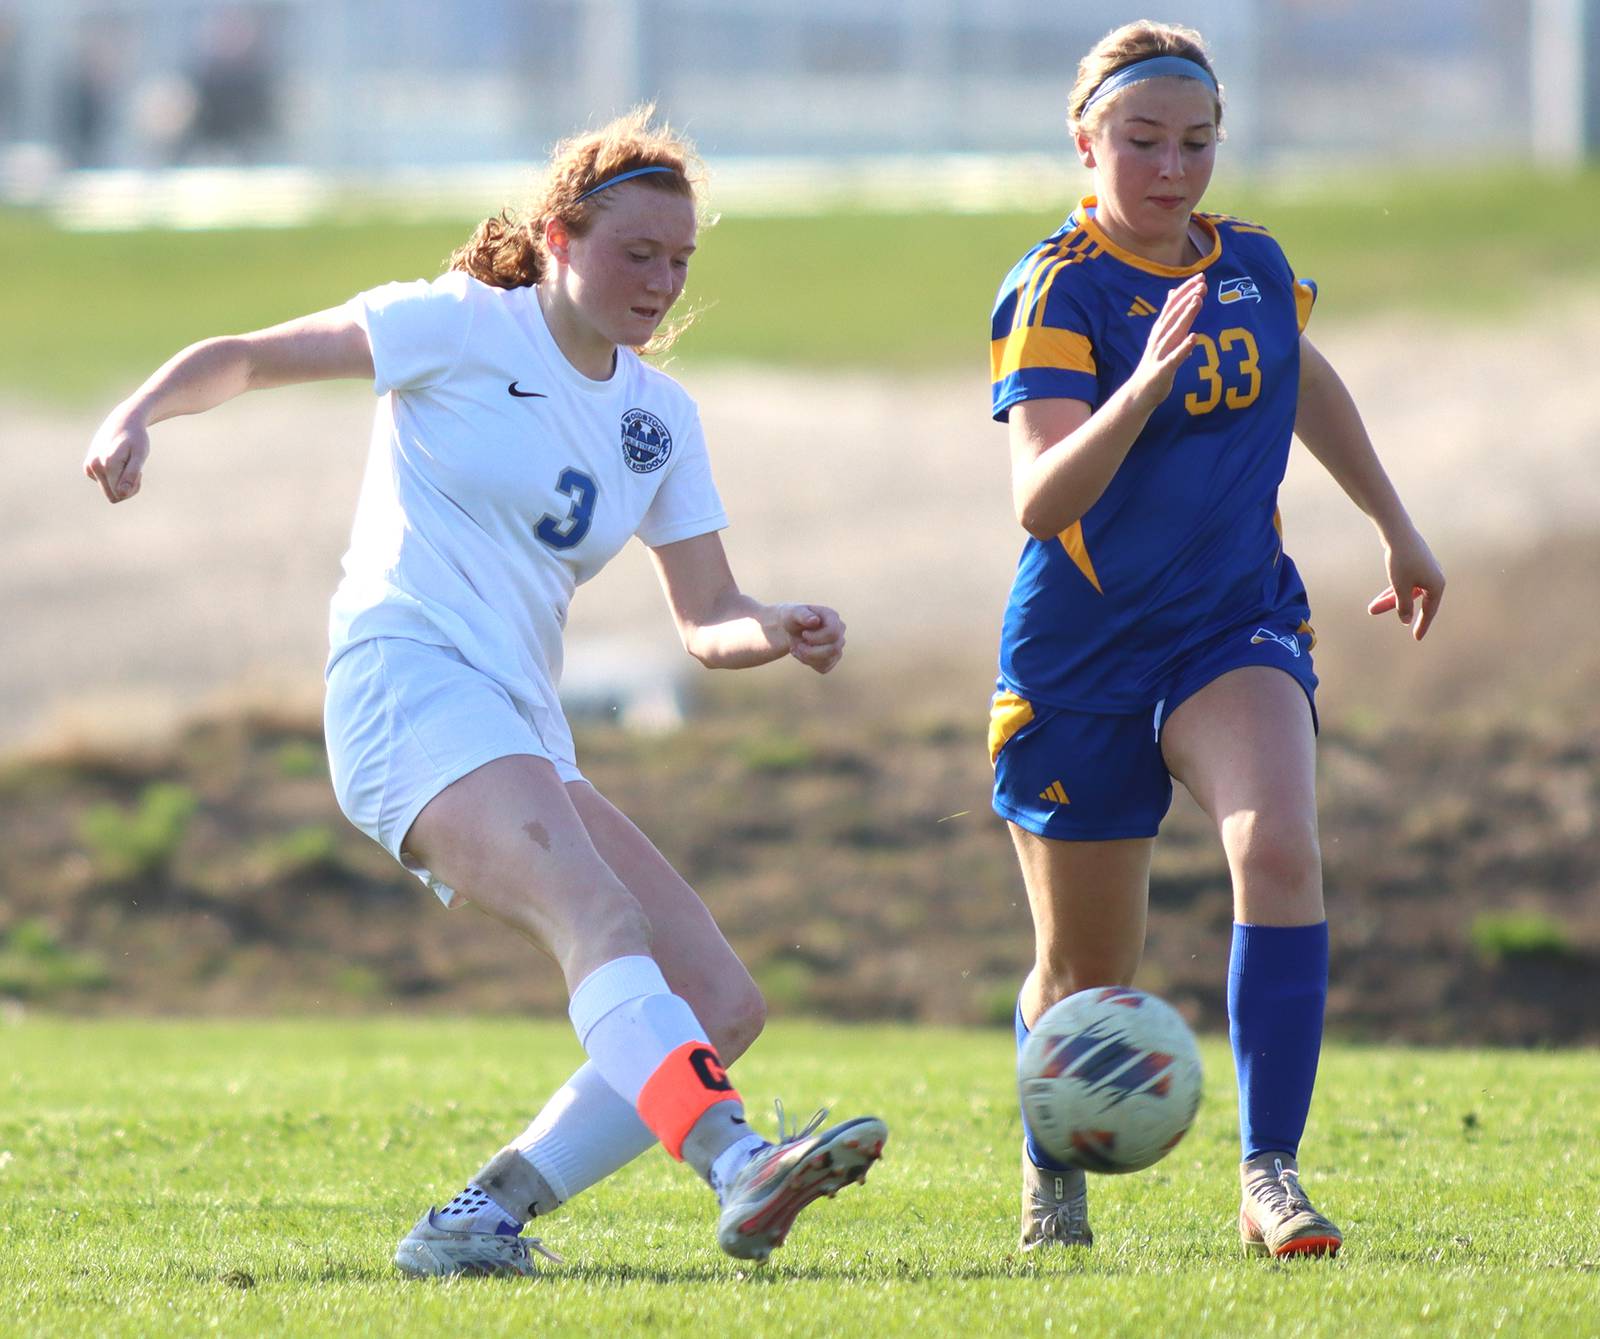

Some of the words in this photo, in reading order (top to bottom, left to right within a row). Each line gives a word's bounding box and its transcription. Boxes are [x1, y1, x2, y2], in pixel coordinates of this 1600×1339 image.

[1185, 327, 1262, 416] 33
[623, 411, 668, 439] WOODSTOCK
[632, 458, 664, 471] SCHOOL
[533, 465, 599, 552] 3
[689, 1048, 734, 1091] C
